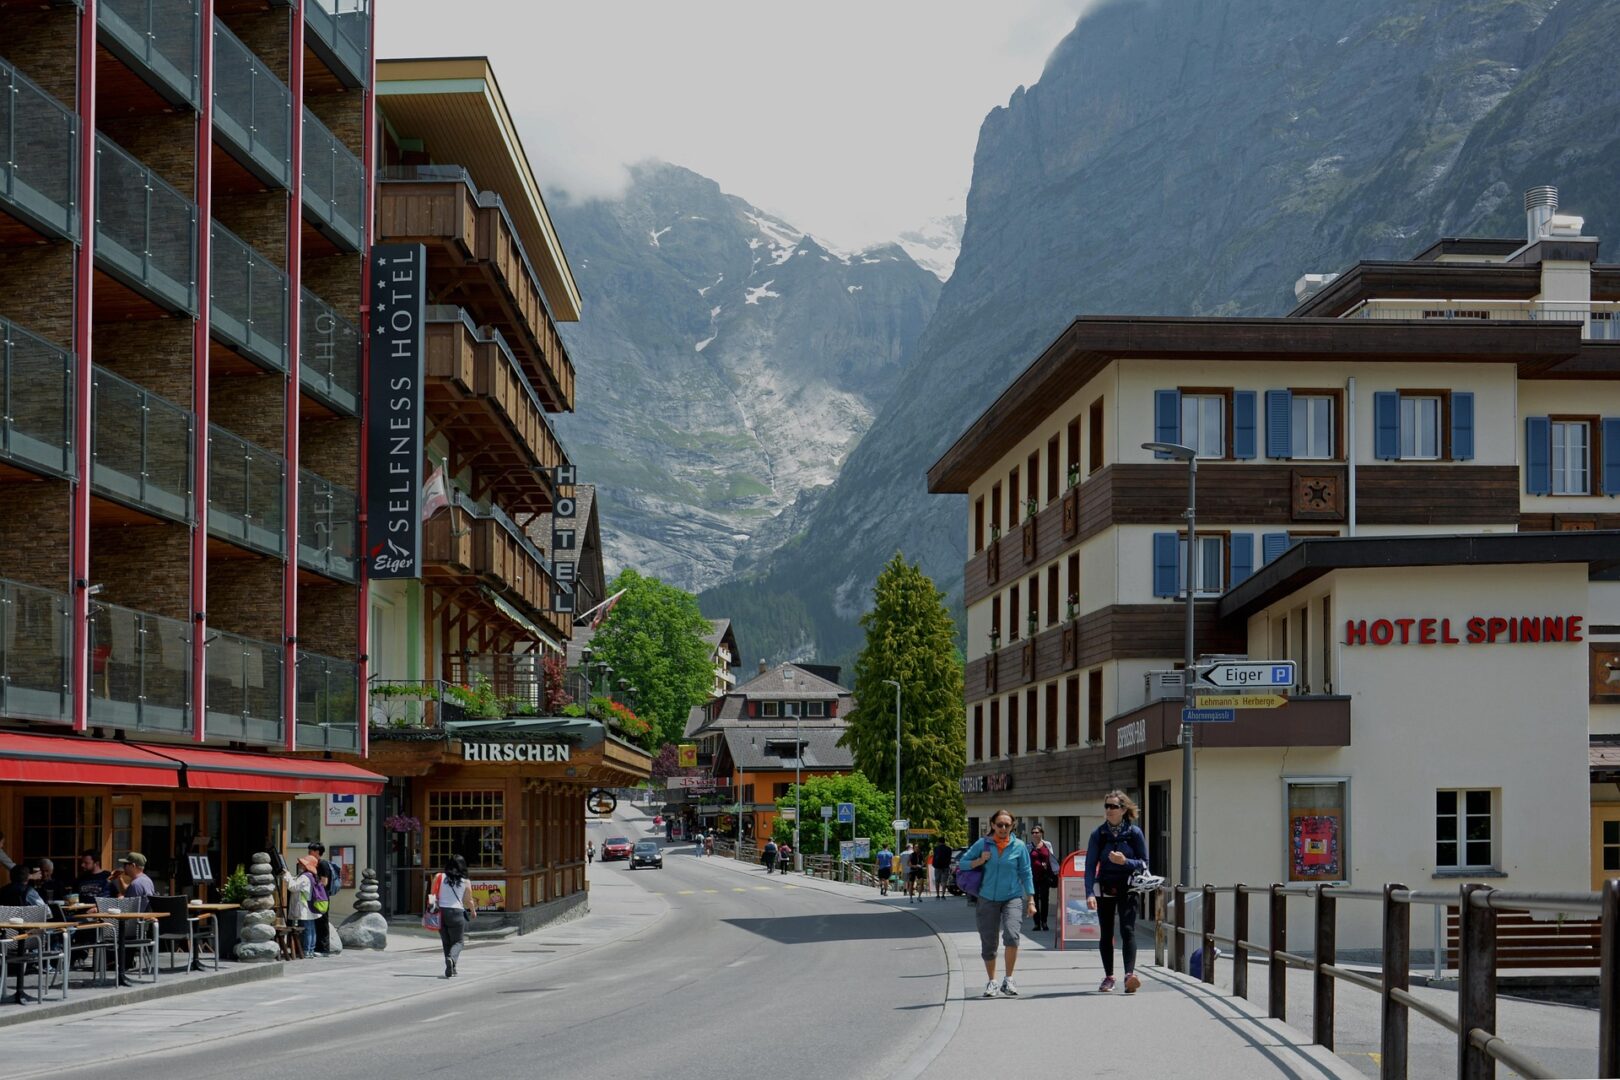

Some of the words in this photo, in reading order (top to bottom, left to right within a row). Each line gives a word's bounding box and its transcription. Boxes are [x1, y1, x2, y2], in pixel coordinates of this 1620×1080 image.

[391, 249, 413, 358] HOTEL
[388, 376, 412, 533] SELFNESS
[555, 466, 575, 612] HOTEL
[374, 554, 413, 573] Eiger
[1346, 618, 1460, 645] HOTEL
[1466, 615, 1583, 643] SPINNE
[1226, 668, 1263, 684] Eiger
[1242, 697, 1275, 707] Herberge
[463, 742, 570, 762] HIRSCHEN
